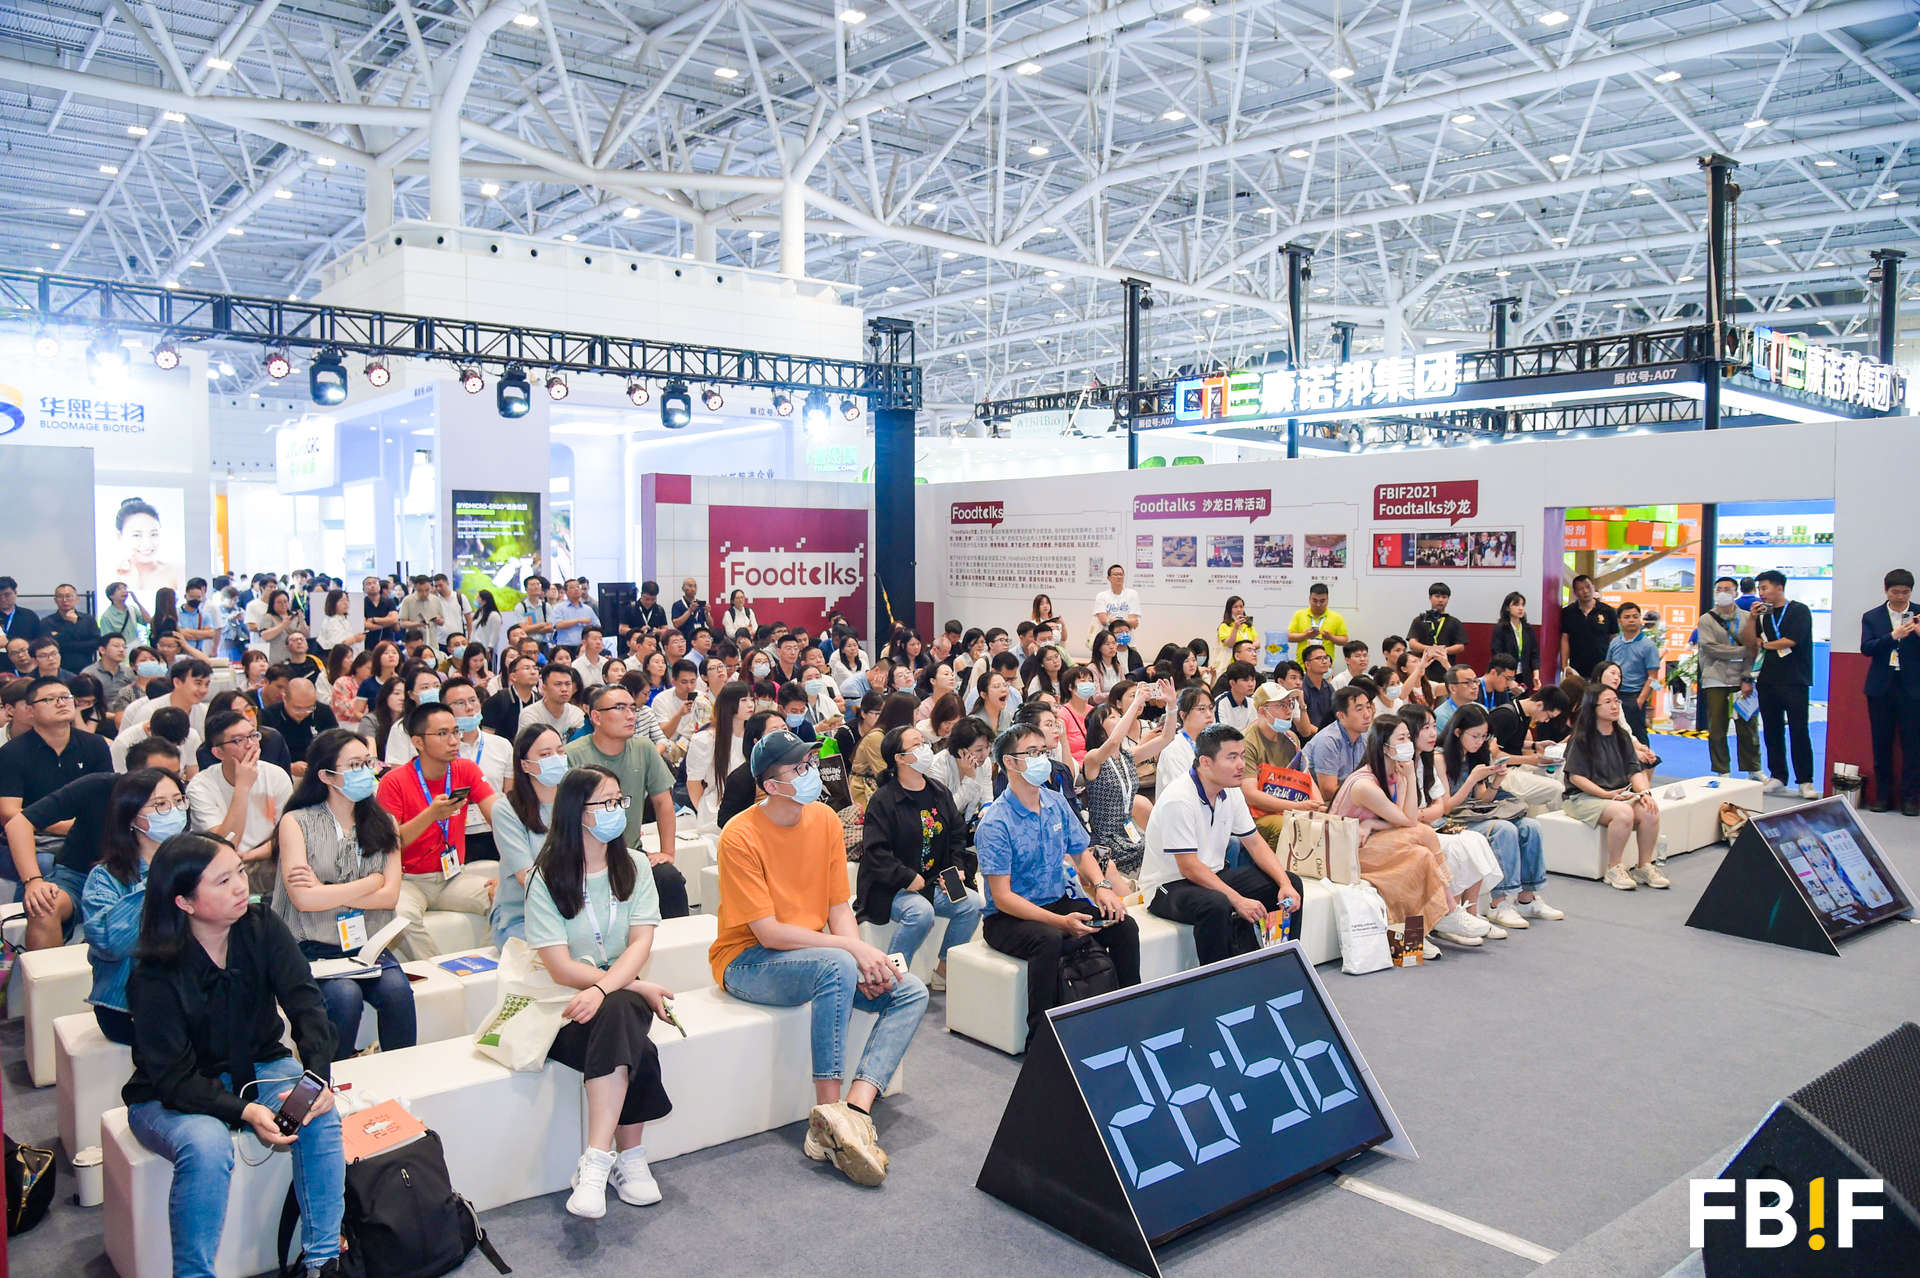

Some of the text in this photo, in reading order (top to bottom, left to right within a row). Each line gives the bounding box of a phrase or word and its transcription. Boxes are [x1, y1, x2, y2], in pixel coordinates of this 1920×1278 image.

[1613, 368, 1678, 386] 展位号:A07
[40, 396, 144, 422] 华熙生物
[40, 420, 144, 433] BLOOMAGE BIOTECH
[1379, 485, 1437, 500] FBIF2021
[1133, 496, 1267, 513] Foodtalks 沙龙日常活动
[1379, 499, 1471, 516] Foodtalks沙龙
[1081, 989, 1360, 1191] 26:56
